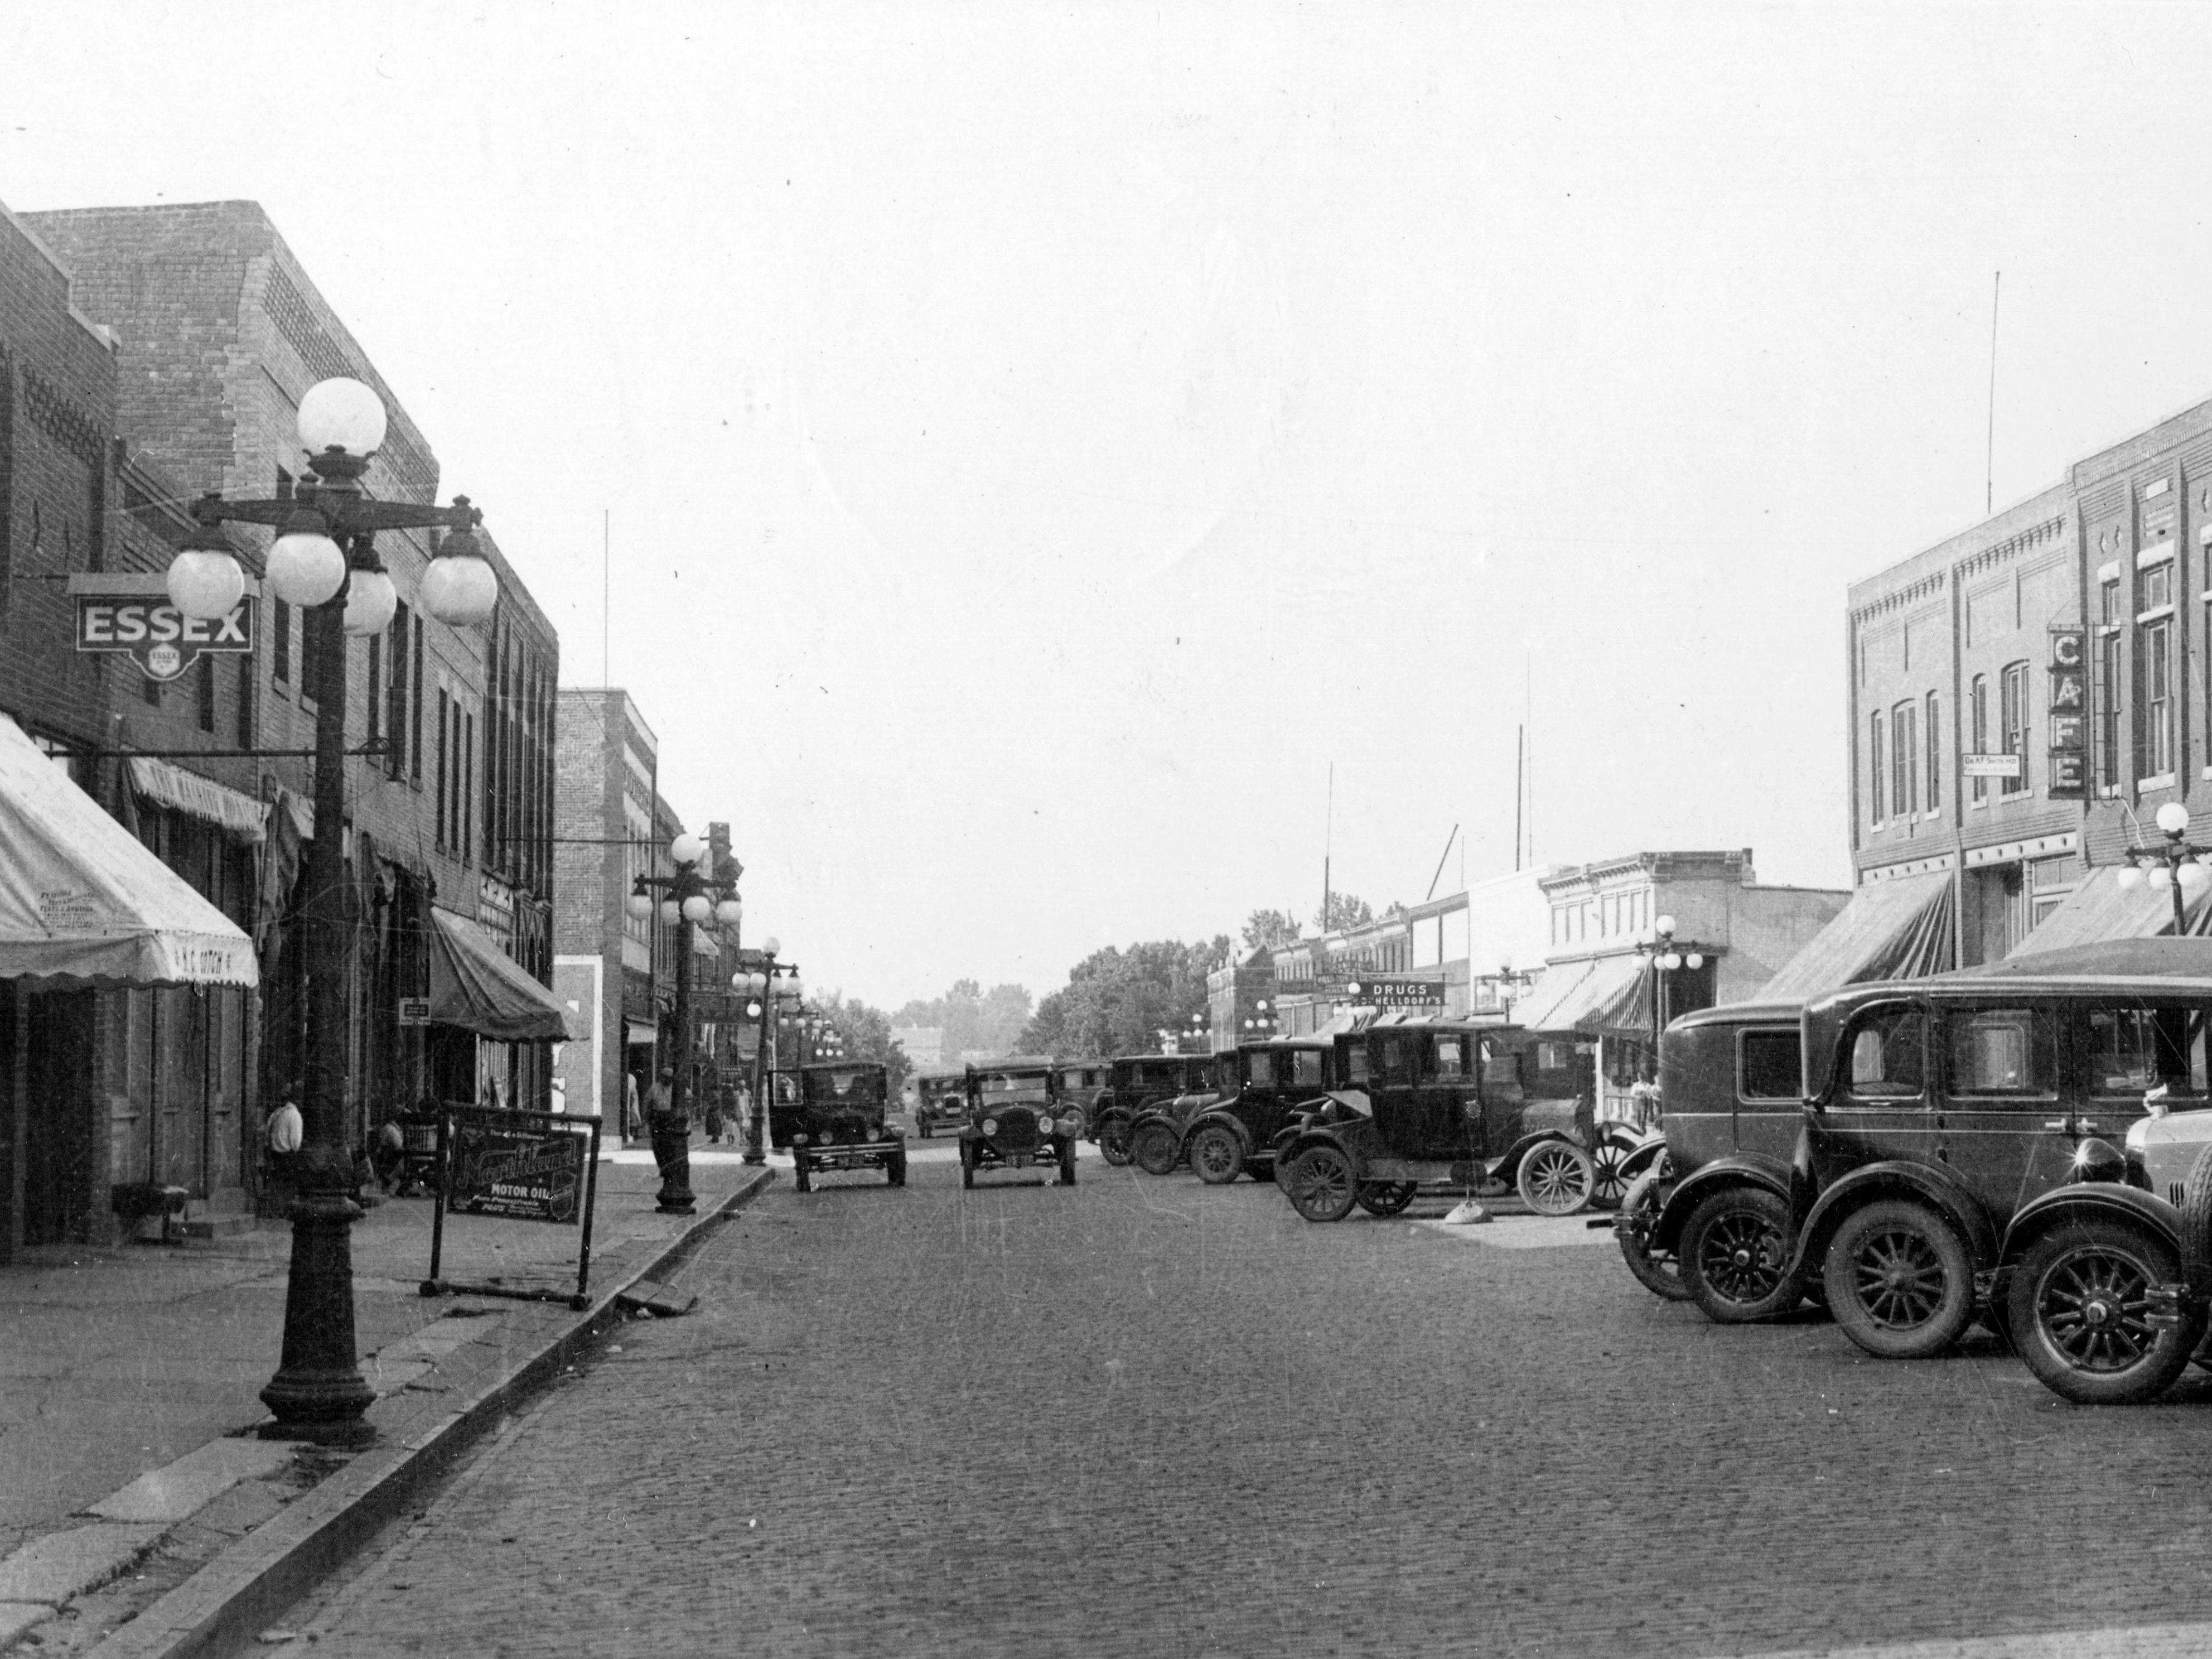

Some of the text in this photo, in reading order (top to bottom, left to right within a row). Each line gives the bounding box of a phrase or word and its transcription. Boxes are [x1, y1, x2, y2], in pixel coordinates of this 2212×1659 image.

[86, 606, 245, 641] ESSEX
[2055, 636, 2081, 787] CAFE
[1374, 985, 1426, 995] DRUGS
[456, 1139, 577, 1189] Northland
[491, 1183, 549, 1199] MOTOR OIL
